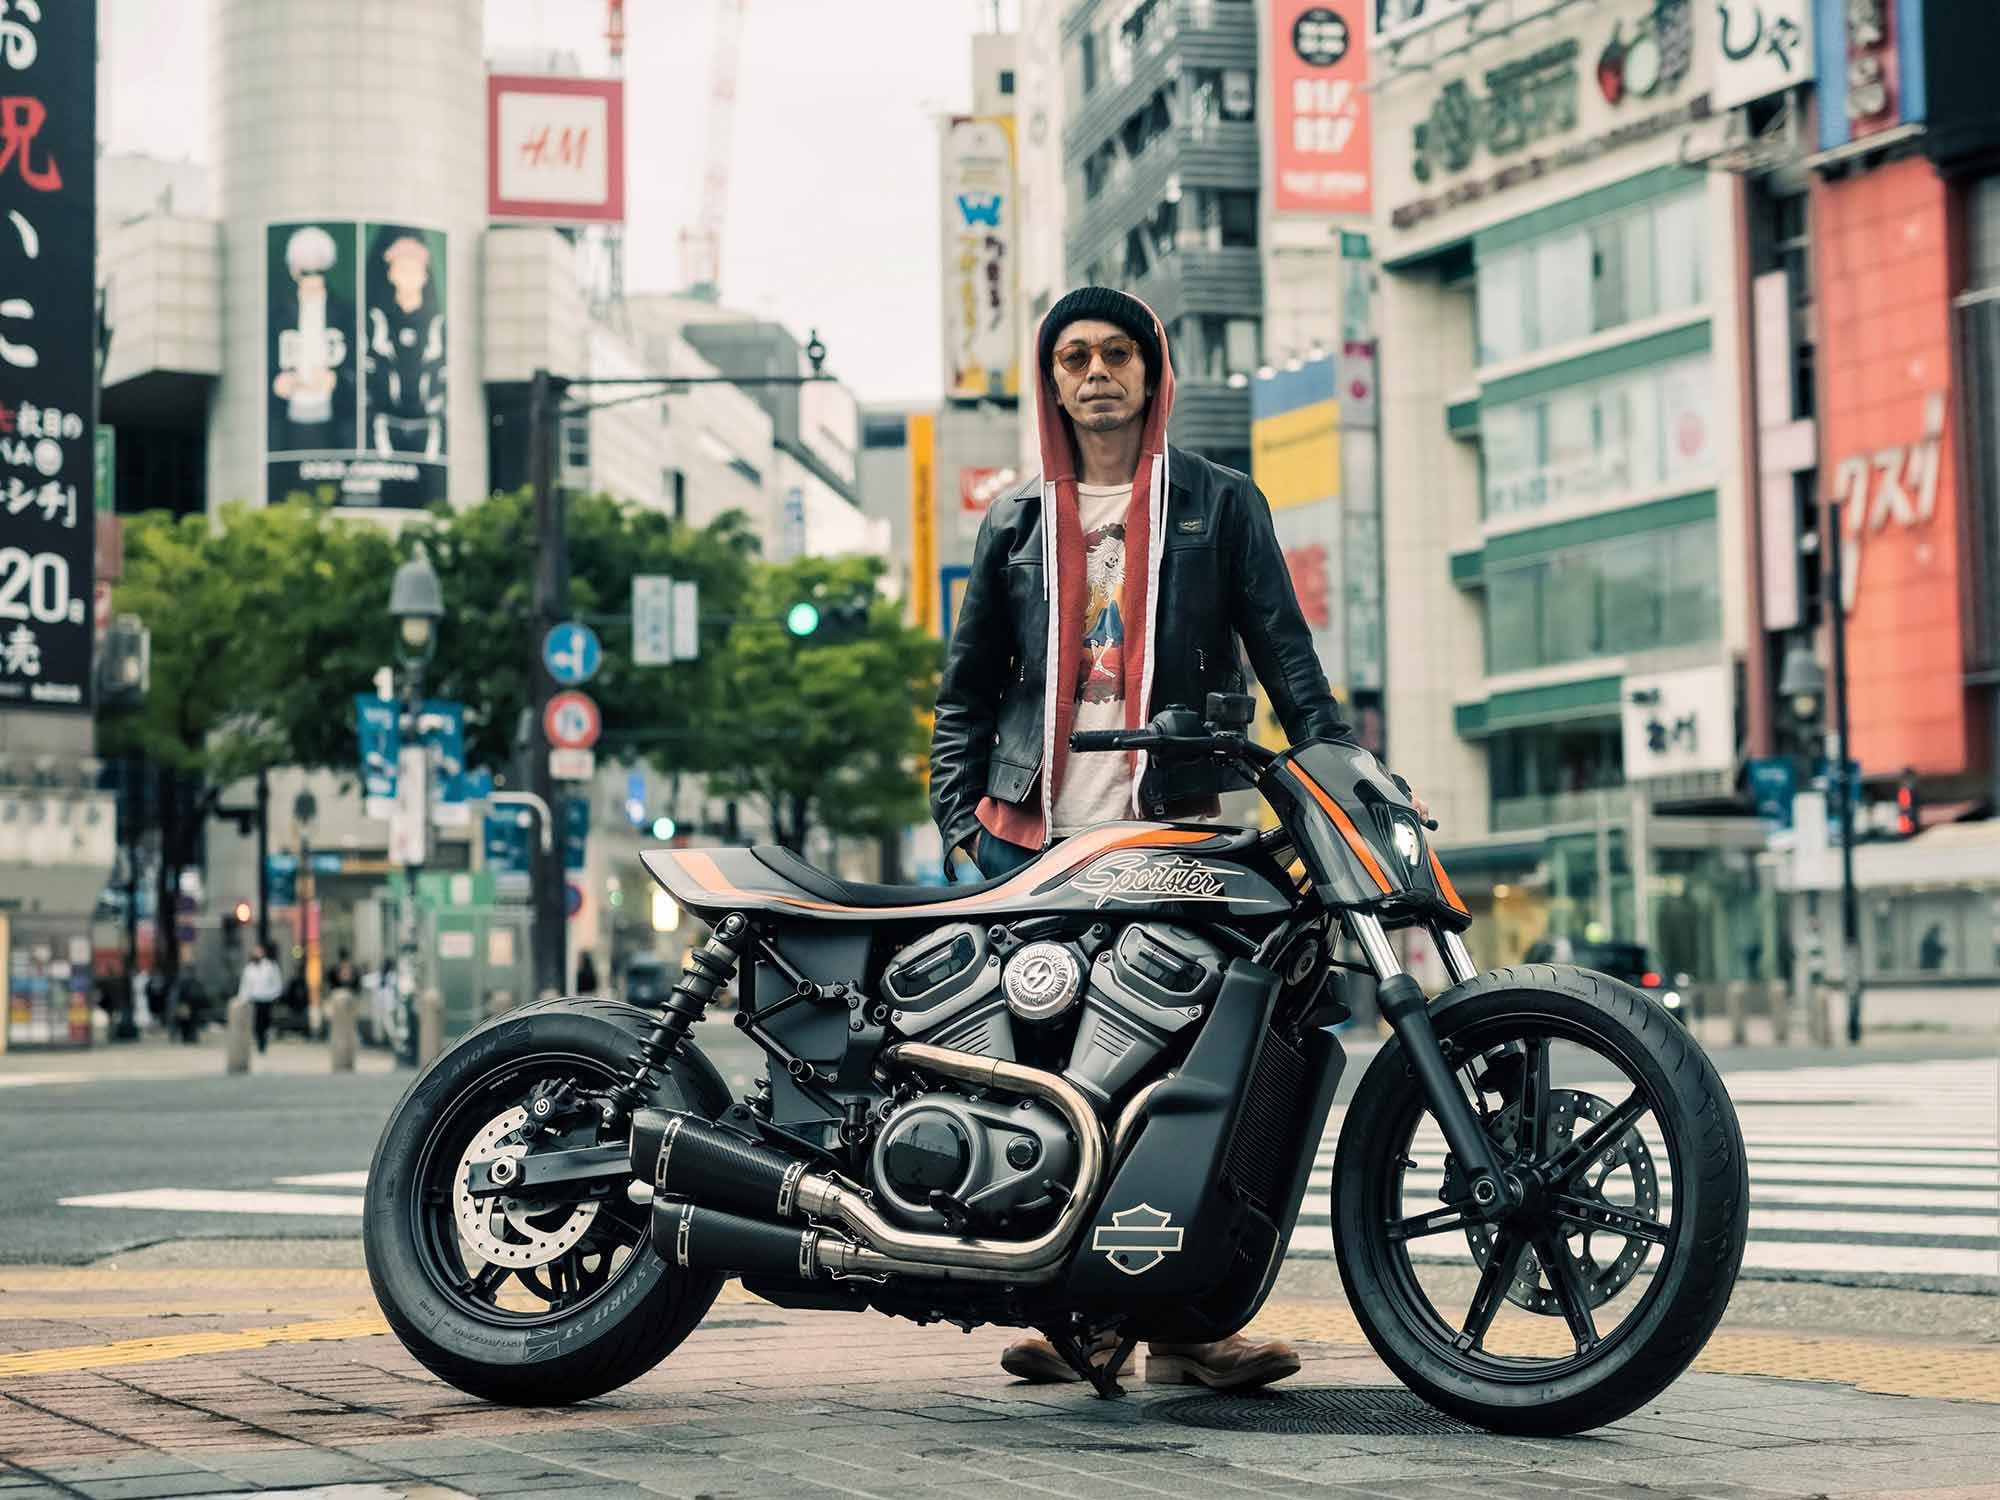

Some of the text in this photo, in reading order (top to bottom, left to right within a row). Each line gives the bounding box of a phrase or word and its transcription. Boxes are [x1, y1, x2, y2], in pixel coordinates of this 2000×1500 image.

[1071, 852, 1250, 909] Sportster
[450, 1040, 498, 1078] AVON
[591, 1268, 647, 1326] SPIRIT
[562, 1320, 585, 1342] ST
